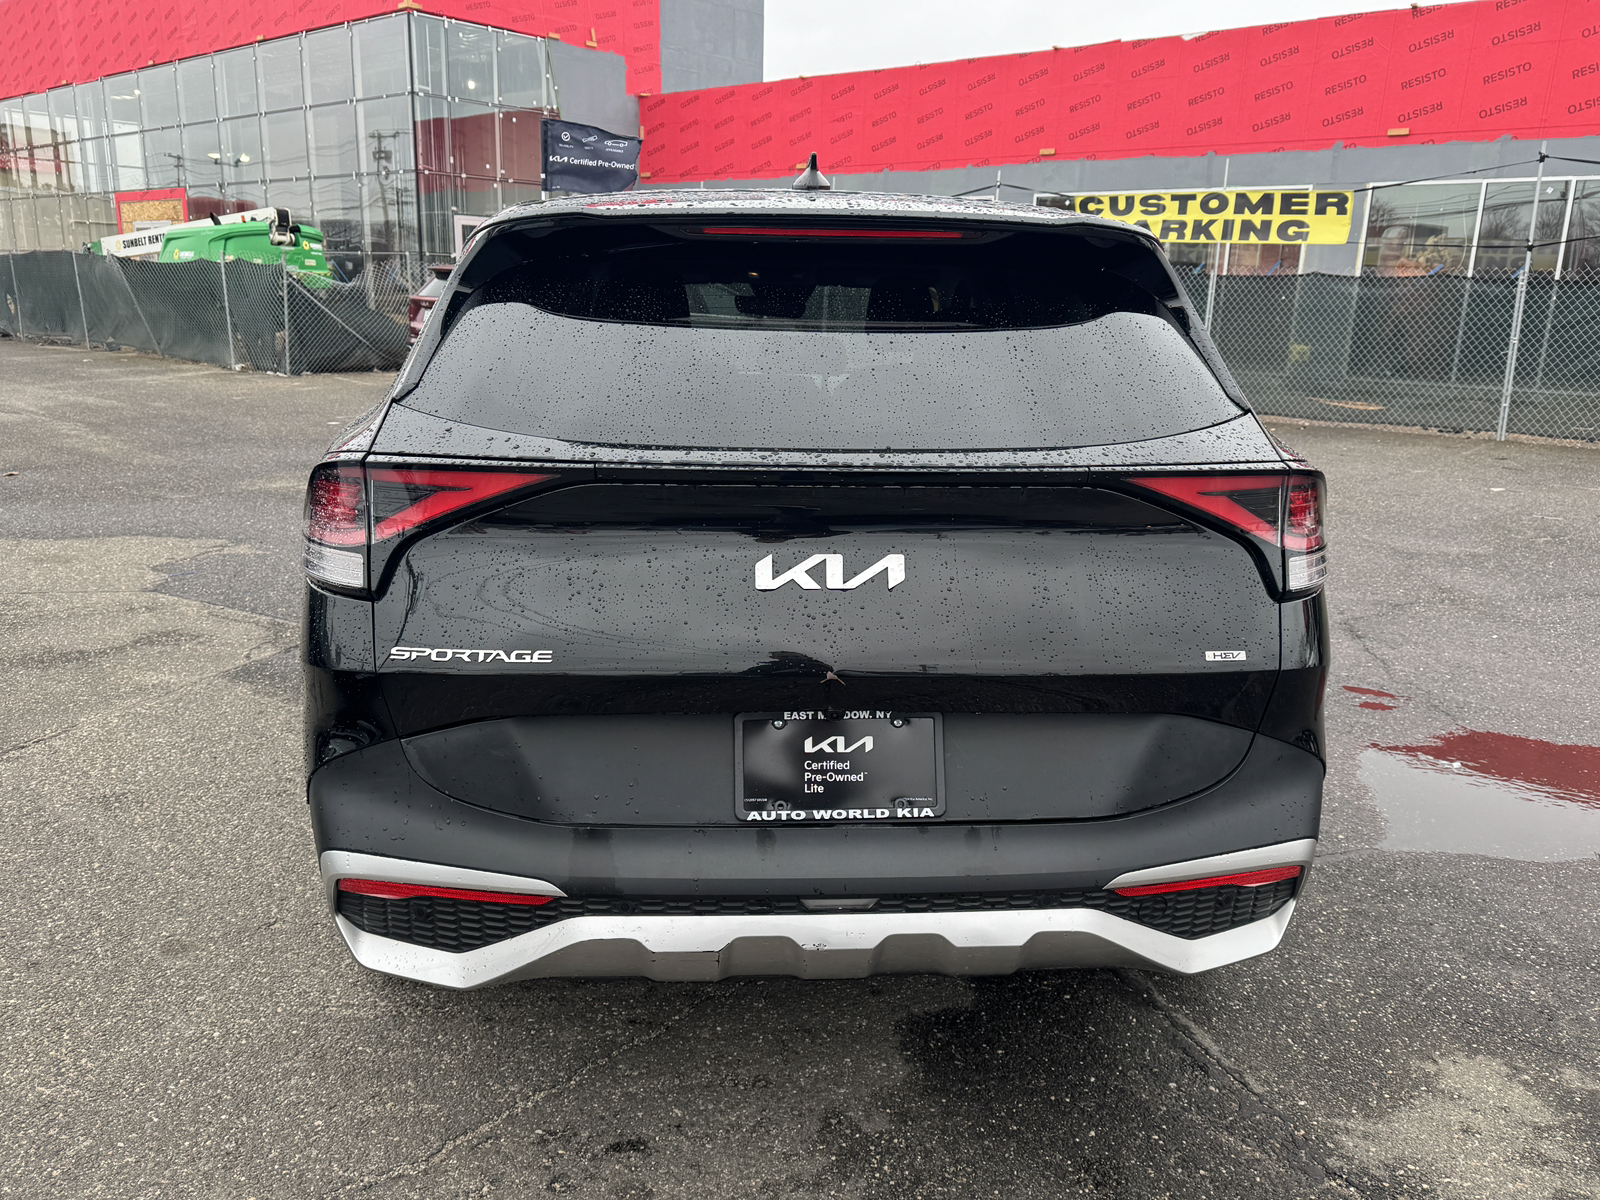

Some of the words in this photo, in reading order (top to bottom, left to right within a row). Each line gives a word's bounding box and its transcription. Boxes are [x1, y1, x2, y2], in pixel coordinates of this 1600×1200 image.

[1408, 29, 1455, 53] RESISTO
[1491, 21, 1541, 46] RESISTO
[1260, 45, 1300, 67] RESISTO
[1331, 37, 1374, 60] RESISTO
[1073, 62, 1105, 82] RESISTO
[1131, 58, 1166, 78] RESISTO
[1193, 52, 1230, 73] RESISTO
[967, 73, 996, 91] RESISTO
[1018, 67, 1049, 86] RESISTO
[1401, 68, 1446, 90] RESISTO
[1483, 61, 1532, 86] RESISTO
[873, 83, 899, 100] RESISTO
[919, 78, 946, 96] RESISTO
[1254, 80, 1294, 102] RESISTO
[1325, 74, 1367, 96] RESISTO
[1069, 94, 1102, 113] RESISTO
[1127, 91, 1161, 111] RESISTO
[1188, 87, 1225, 107] RESISTO
[917, 107, 944, 125] RESISTO
[965, 102, 993, 121] RESISTO
[1015, 98, 1046, 117] RESISTO
[1322, 106, 1364, 128] RESISTO
[1397, 101, 1443, 123] RESISTO
[1479, 96, 1528, 119] RESISTO
[872, 111, 897, 128] RESISTO
[1186, 117, 1223, 136] RESISTO
[1252, 112, 1291, 132] RESISTO
[965, 129, 993, 147] RESISTO
[1015, 125, 1045, 144] RESISTO
[1068, 122, 1100, 141] RESISTO
[1126, 120, 1160, 140] RESISTO
[871, 136, 897, 152] RESISTO
[917, 133, 943, 150] RESISTO
[569, 157, 597, 167] Certified
[597, 159, 635, 170] Pre-Owned
[1079, 192, 1350, 216] CUSTOMER
[1134, 219, 1311, 242] RKING
[122, 236, 147, 249] SUNBELT
[390, 646, 553, 663] SPORTAGE
[1211, 651, 1243, 660] HEV
[783, 711, 815, 720] EAST
[876, 710, 893, 719] NY
[804, 760, 850, 770] Certified
[804, 783, 824, 793] Lite
[746, 810, 807, 821] AUTO
[812, 808, 890, 820] WORLD
[896, 807, 935, 818] KIA
